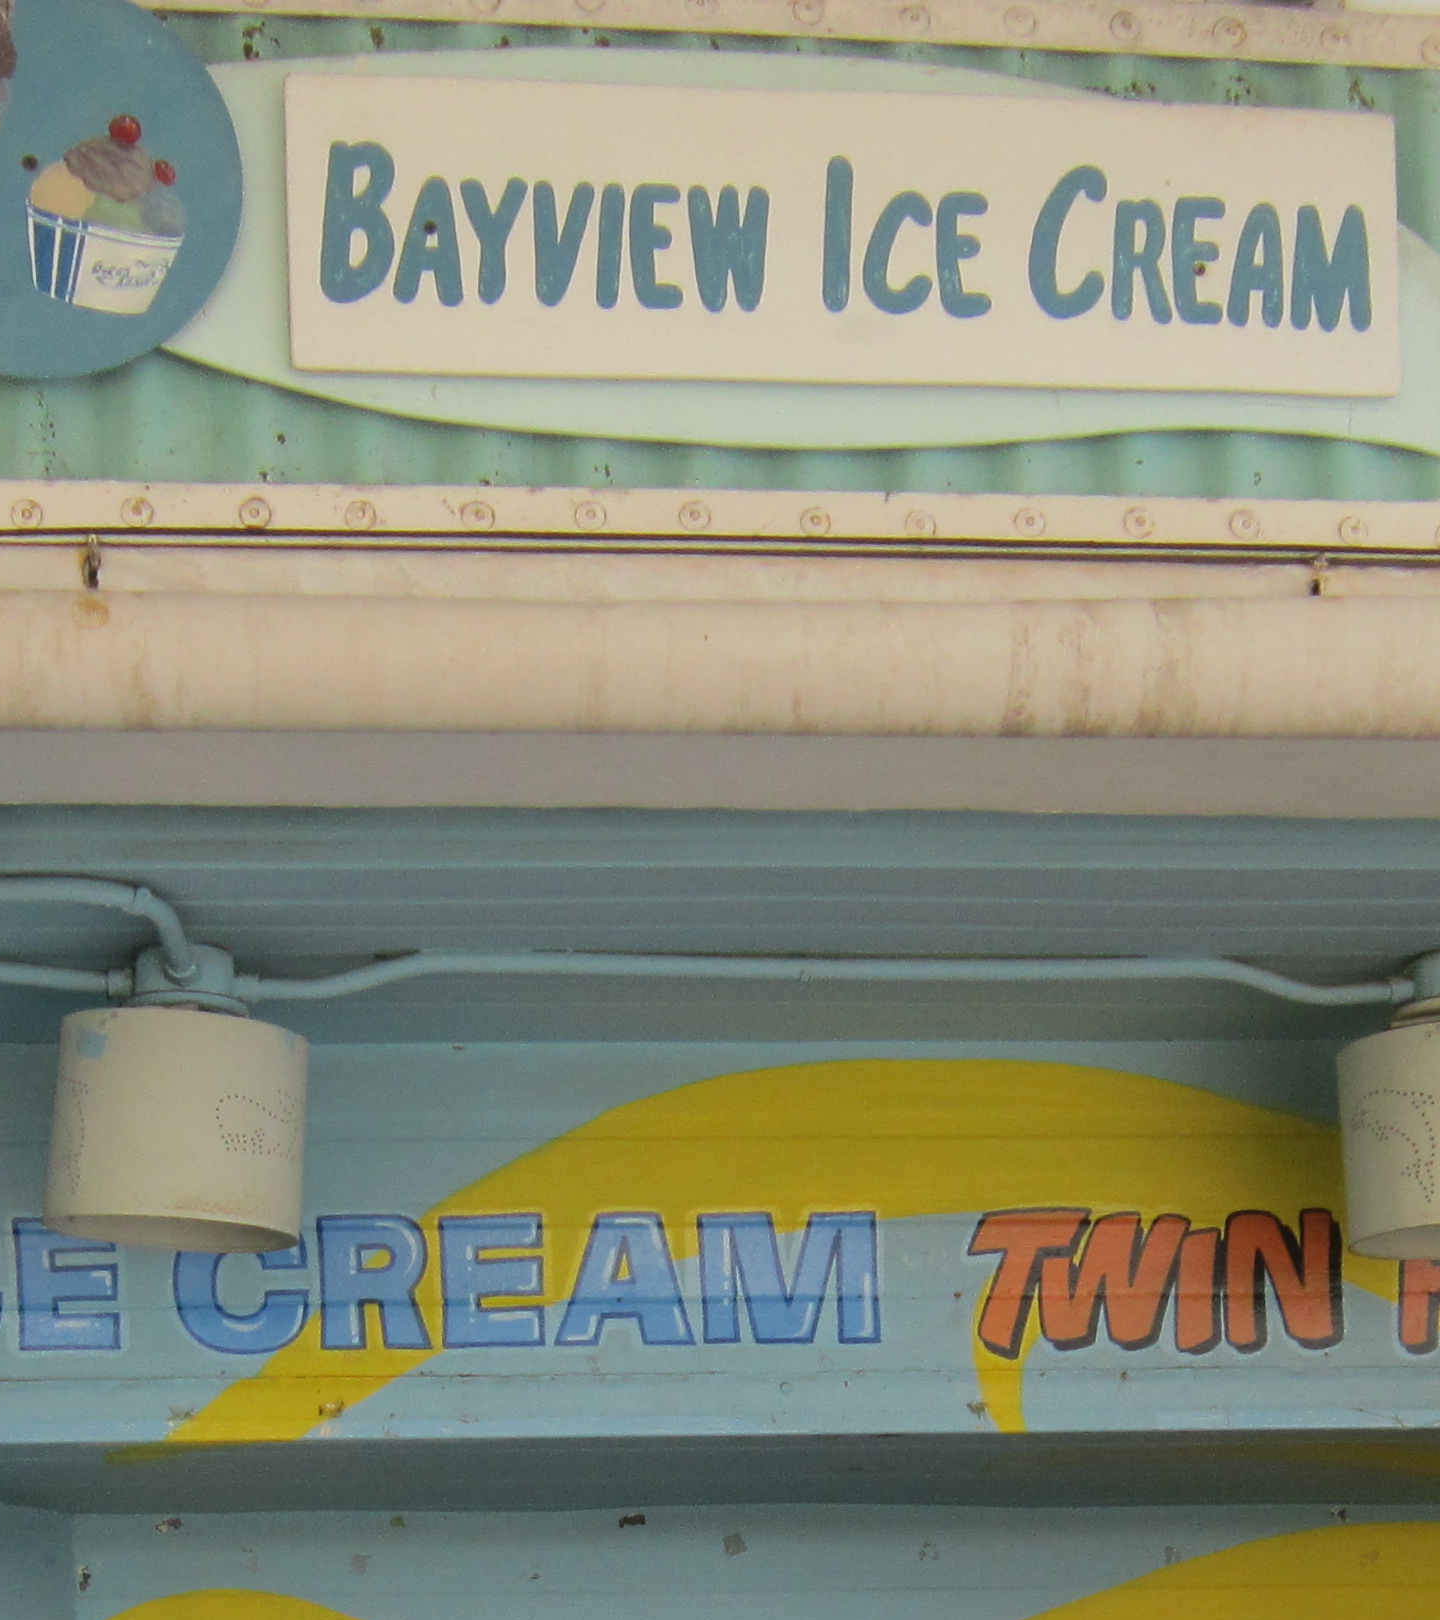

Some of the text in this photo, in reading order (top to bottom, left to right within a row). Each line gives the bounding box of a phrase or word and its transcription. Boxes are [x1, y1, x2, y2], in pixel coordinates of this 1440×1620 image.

[318, 139, 1374, 333] BAYVIEW ICE CREAM
[170, 1210, 883, 1353] CREAM
[966, 1206, 1345, 1358] TWIN
